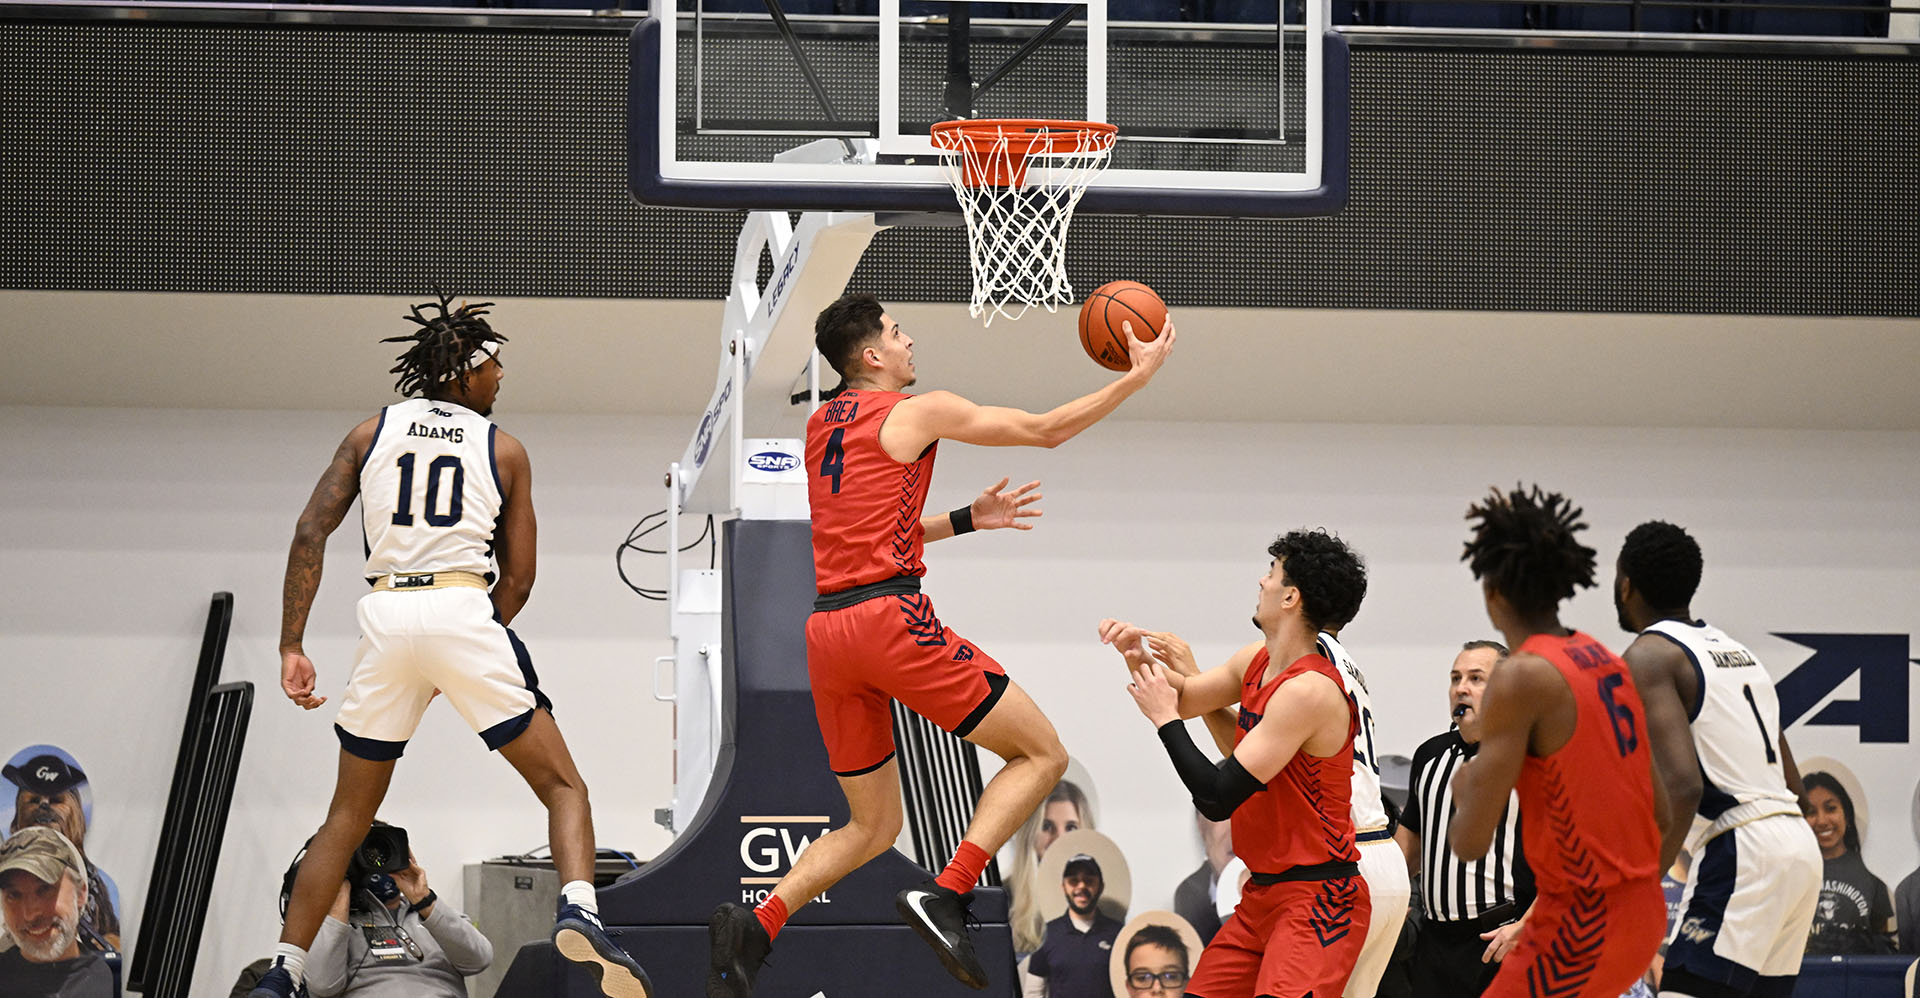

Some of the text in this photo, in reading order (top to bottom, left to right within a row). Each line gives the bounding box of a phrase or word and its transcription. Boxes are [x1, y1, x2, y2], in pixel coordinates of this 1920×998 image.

[768, 241, 799, 317] LEGACY
[406, 421, 465, 443] ADAMS
[824, 400, 859, 423] BREA
[820, 427, 846, 494] 4
[391, 451, 465, 528] 10
[1743, 683, 1777, 765] 1
[36, 766, 59, 782] GW
[741, 827, 831, 873] GW
[742, 889, 831, 904] HOAL
[1820, 880, 1869, 917] ASHINGTON
